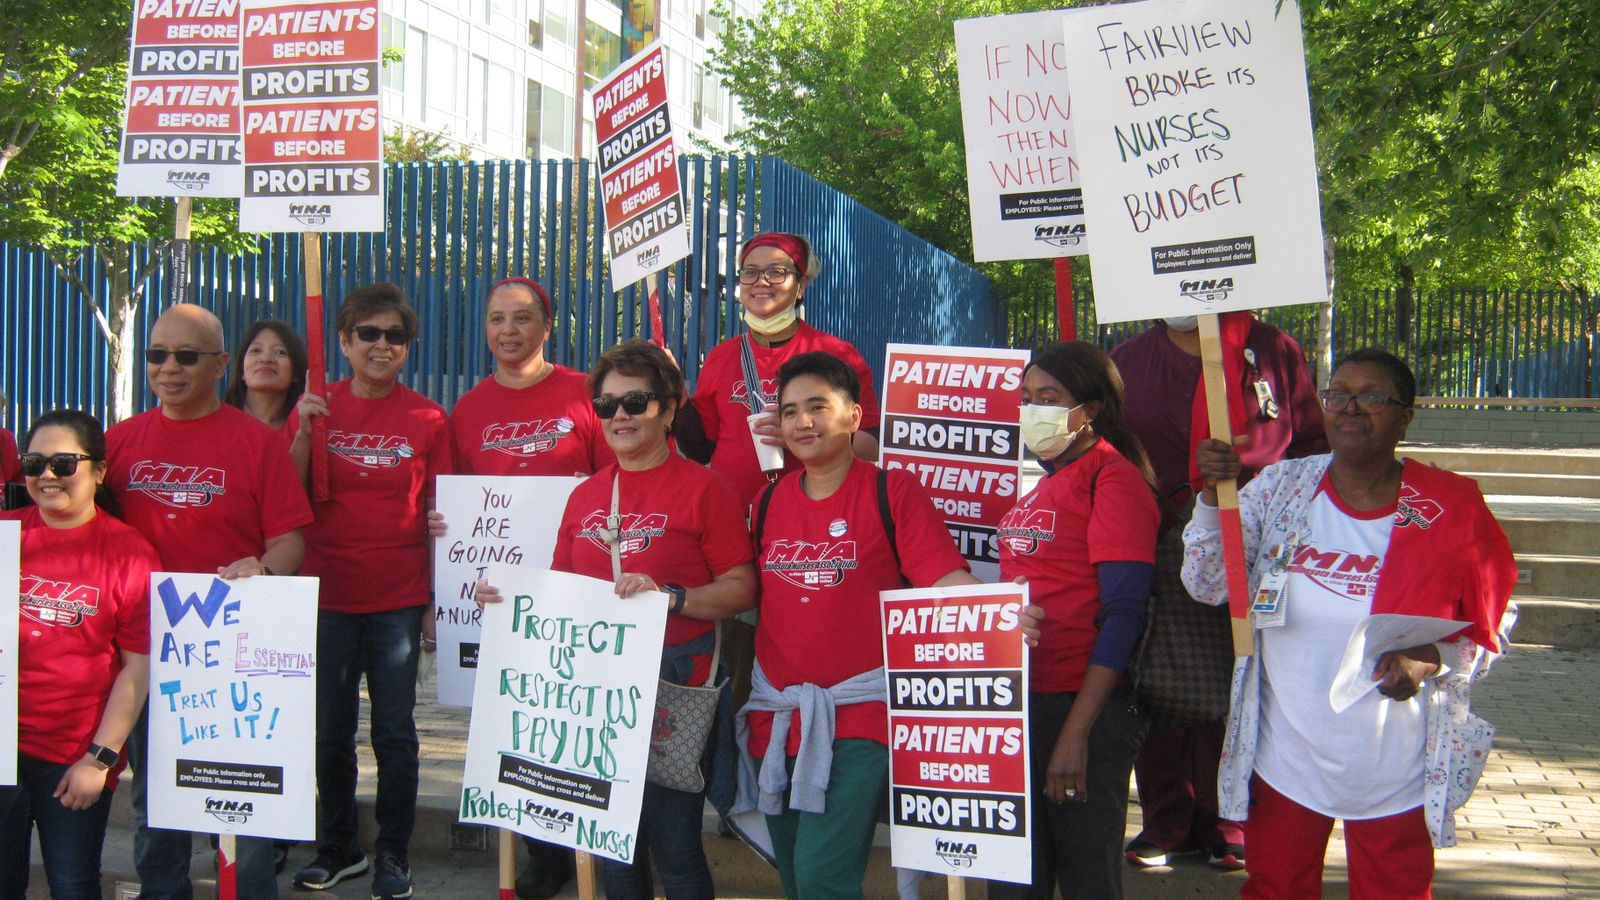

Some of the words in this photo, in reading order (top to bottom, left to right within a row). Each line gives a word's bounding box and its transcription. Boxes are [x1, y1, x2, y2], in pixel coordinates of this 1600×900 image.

[140, 0, 240, 19] PATIEN
[245, 7, 376, 38] PATIENTS
[167, 24, 238, 38] BEFORE
[273, 40, 345, 59] BEFORE
[1096, 20, 1252, 70] FAIRVIEW
[141, 50, 240, 72] PROFIT
[985, 44, 1011, 80] IF
[1026, 40, 1067, 78] NO
[251, 68, 370, 96] PROFITS
[595, 54, 662, 118] PATIENTS
[1126, 67, 1216, 107] BROKE
[1226, 68, 1255, 86] ITS
[131, 86, 240, 106] PATIENT
[988, 90, 1070, 126] NOW
[158, 113, 230, 128] BEFORE
[246, 108, 377, 134] PATIENTS
[611, 92, 650, 129] BEFORE
[274, 140, 346, 157] BEFORE
[603, 111, 666, 168] PROFITS
[998, 129, 1068, 153] THEN
[1113, 108, 1231, 163] NURSES
[604, 144, 673, 202] PATIENTS
[1147, 154, 1180, 178] NOT
[1194, 144, 1224, 164] ITS
[168, 172, 210, 180] MNA
[252, 167, 371, 192] PROFITS
[290, 205, 330, 214] MNA
[621, 182, 660, 216] BEFORE
[1122, 173, 1246, 233] BUDGET
[614, 201, 678, 254] PROFITS
[1036, 224, 1086, 236] MNA
[638, 245, 660, 262] MNA
[1156, 260, 1186, 269] Employees:
[1187, 257, 1204, 266] please
[1168, 249, 1190, 258] Public
[1191, 244, 1233, 256] Information
[1234, 242, 1252, 250] Only
[1182, 278, 1233, 292] MNA
[890, 360, 1022, 391] PATIENTS
[918, 393, 986, 414] BEFORE
[892, 420, 1010, 454] PROFITS
[131, 466, 225, 488] MNA
[482, 486, 512, 512] YOU
[930, 497, 982, 518] FORE
[472, 516, 511, 539] ARE
[448, 540, 523, 565] GOING
[766, 541, 856, 563] MNA
[1291, 547, 1380, 573] MN
[476, 566, 488, 580] T
[436, 606, 444, 621] A
[449, 607, 482, 627] NUR
[512, 595, 636, 656] PROTECT
[887, 603, 1020, 635] PATIENTS
[160, 632, 221, 668] ARE
[550, 646, 575, 680] US
[914, 642, 984, 662] BEFORE
[160, 680, 218, 712] TREAT
[896, 676, 1013, 706] PROFITS
[234, 707, 280, 740] IT!
[512, 710, 568, 764] PAY
[893, 724, 1022, 756] PATIENTS
[180, 775, 213, 783] EMPLOYEES:
[528, 769, 543, 780] Public
[544, 772, 578, 787] Information
[578, 783, 592, 792] only
[919, 761, 990, 784] BEFORE
[504, 771, 537, 786] EMPLOYEES:
[537, 781, 555, 791] Please
[556, 787, 571, 795] cross
[585, 793, 605, 803] deliver
[206, 800, 253, 812] MNA
[526, 802, 574, 822] MNA
[900, 793, 1016, 831] PROFITS
[937, 841, 977, 854] MNA
